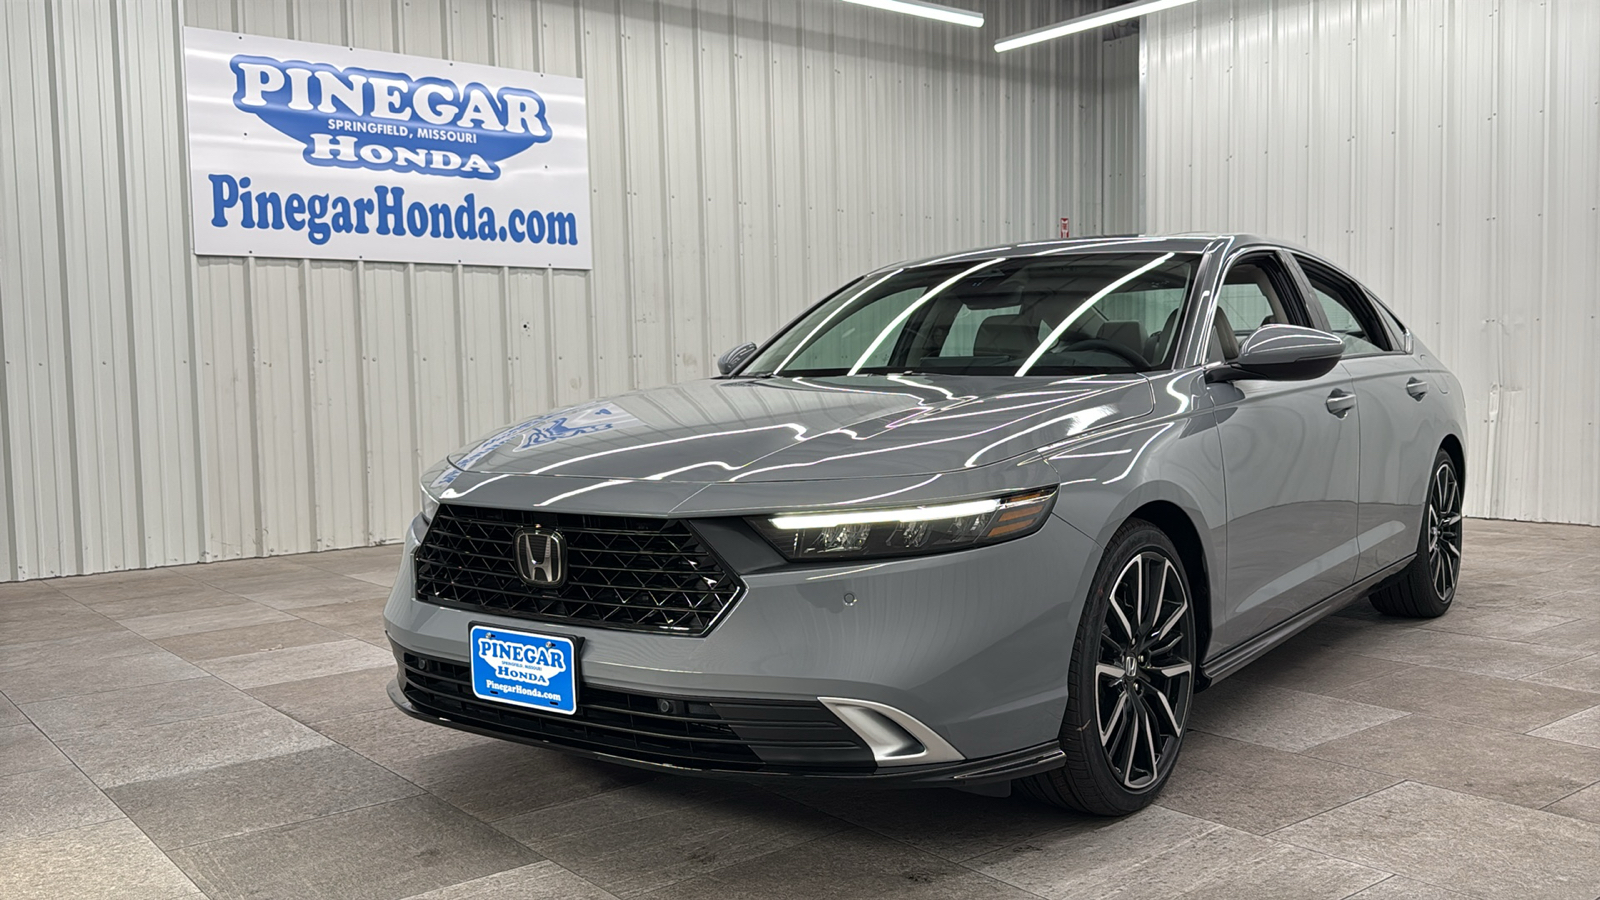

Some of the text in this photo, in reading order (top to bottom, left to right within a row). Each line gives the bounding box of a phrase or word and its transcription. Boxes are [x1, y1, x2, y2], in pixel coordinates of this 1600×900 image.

[237, 62, 547, 137] PINEGAR
[327, 118, 478, 144] SPRINGFIELD, MISSOURI
[310, 133, 495, 174] HONDA
[208, 173, 579, 246] PinegarHonda.com
[481, 641, 564, 669] PINEGAR
[497, 666, 547, 683] HONDA
[486, 679, 562, 701] PinegarHonda.com
